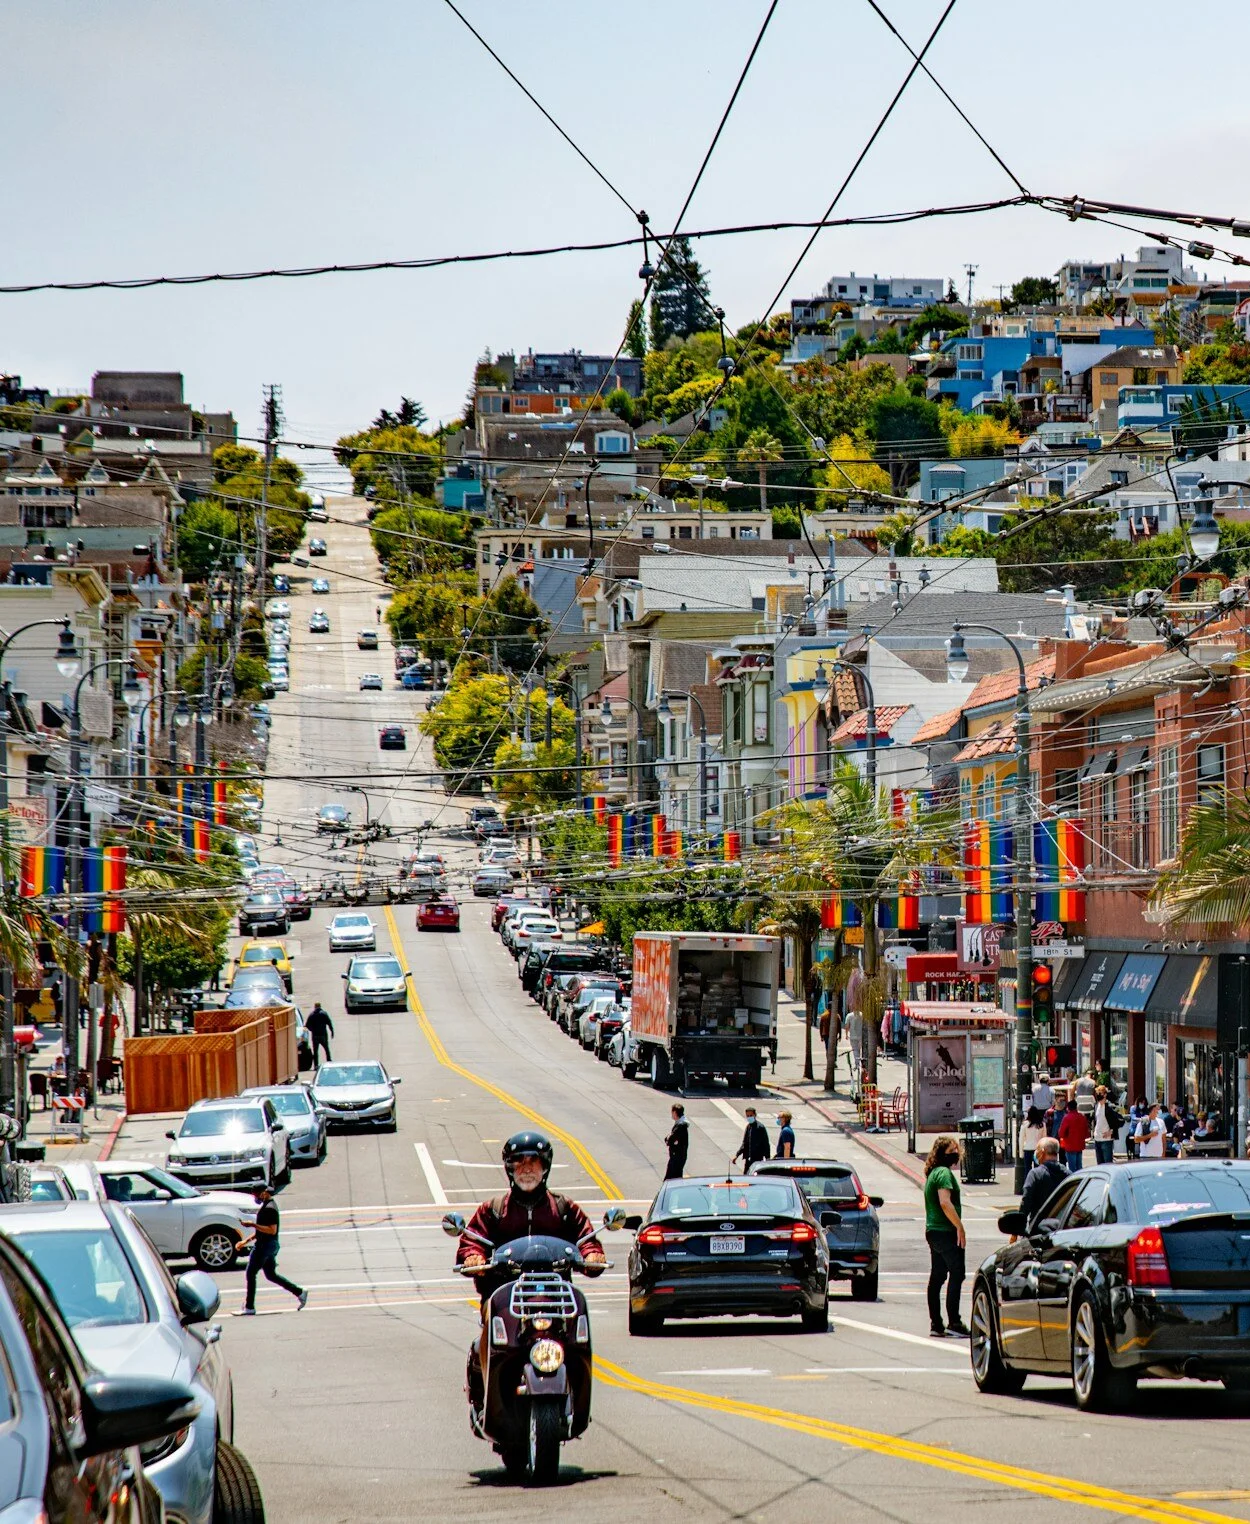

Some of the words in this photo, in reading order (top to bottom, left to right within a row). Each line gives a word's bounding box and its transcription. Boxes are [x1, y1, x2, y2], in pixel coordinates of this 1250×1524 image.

[8, 803, 45, 825] actory
[984, 930, 1006, 941] CAST
[985, 944, 1000, 956] STR
[1043, 948, 1058, 956] 18th
[1063, 948, 1073, 956] St
[923, 1065, 966, 1080] Explod
